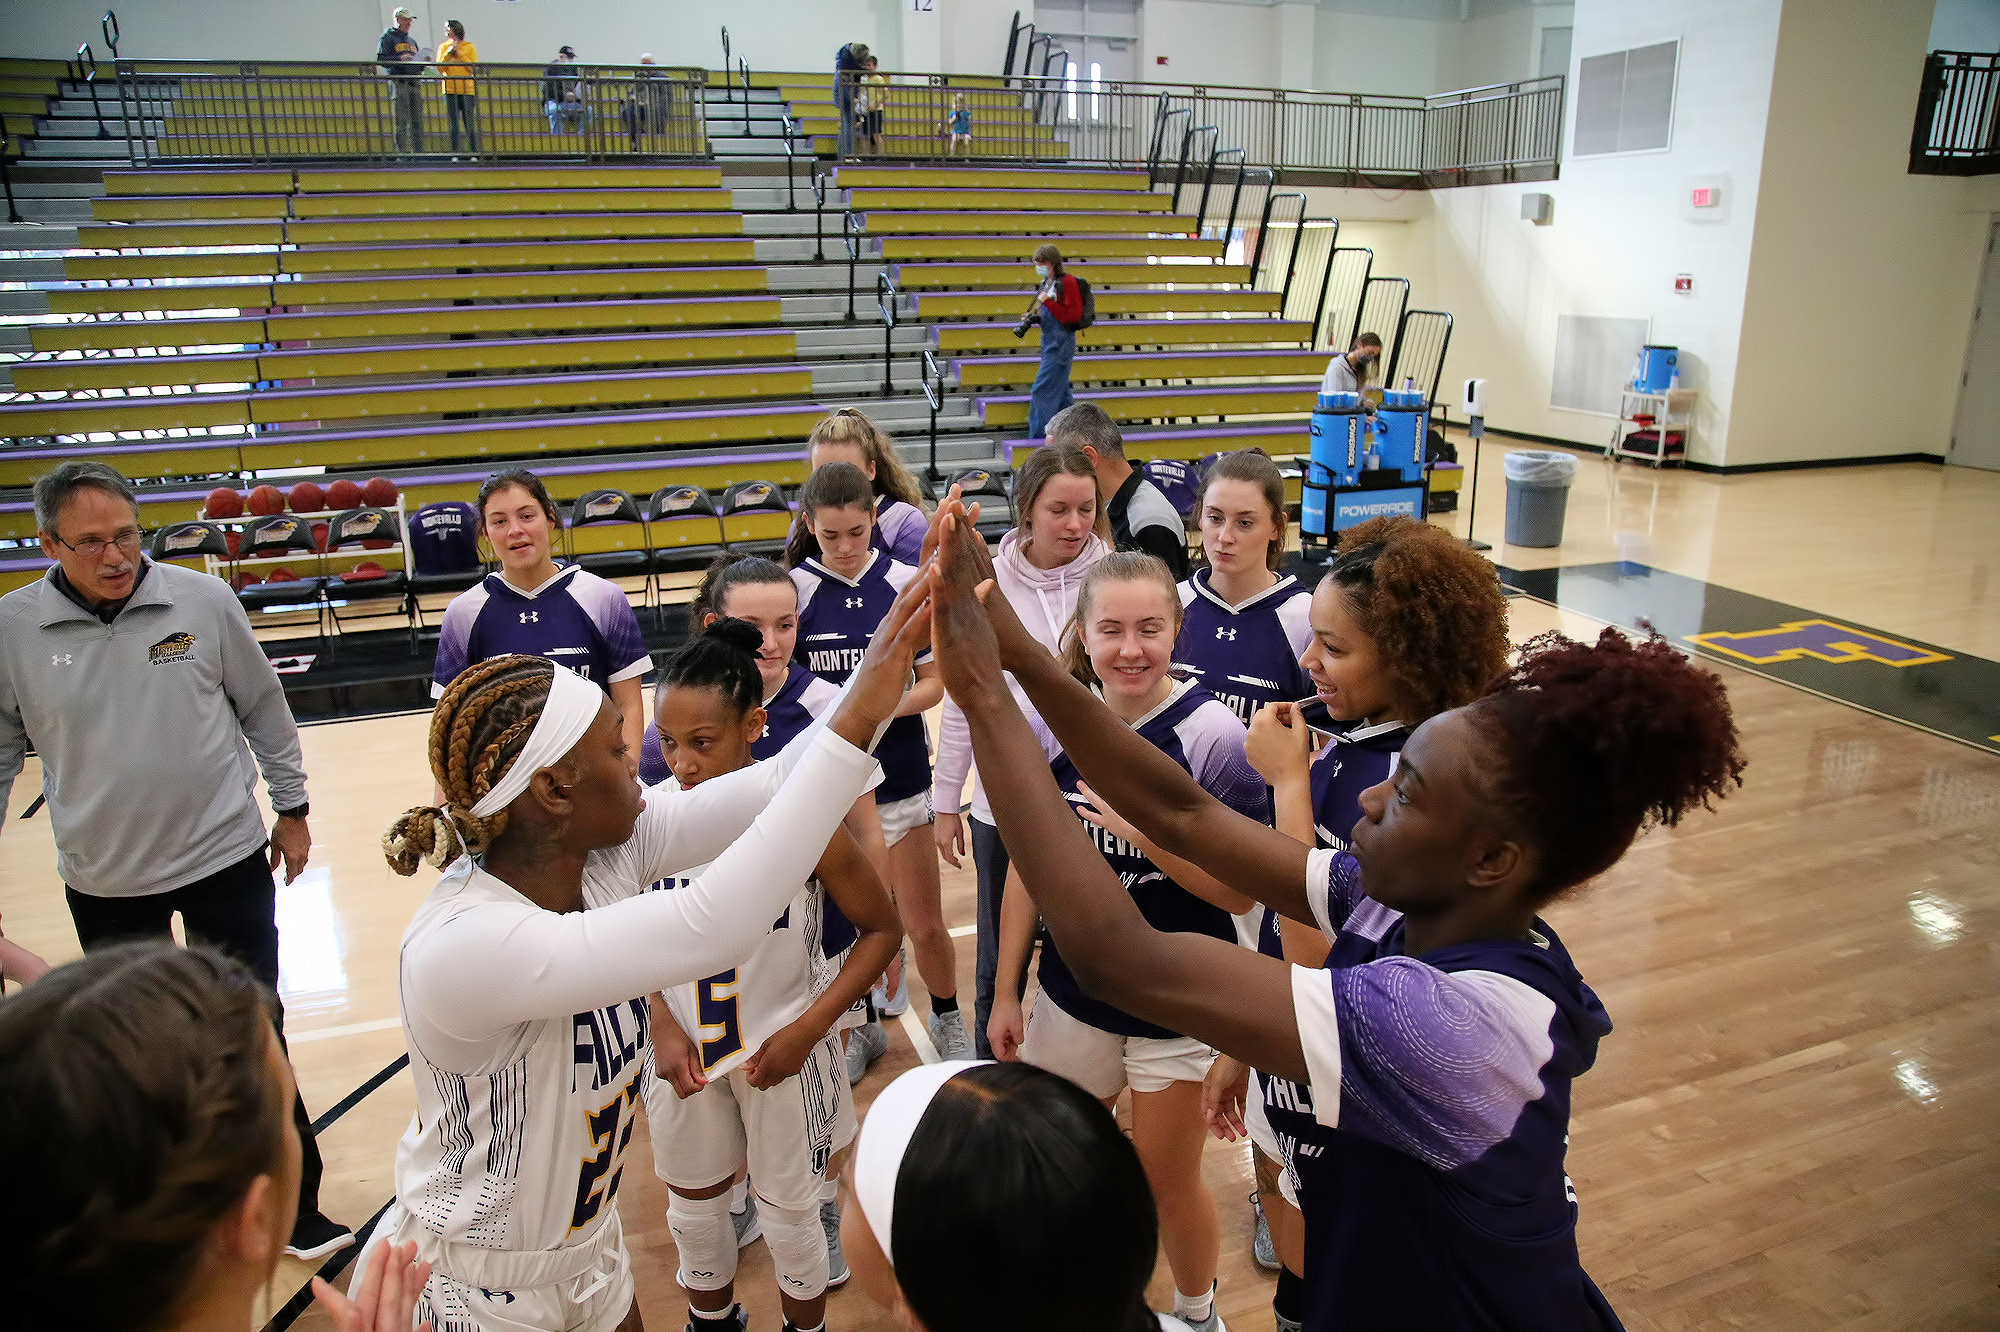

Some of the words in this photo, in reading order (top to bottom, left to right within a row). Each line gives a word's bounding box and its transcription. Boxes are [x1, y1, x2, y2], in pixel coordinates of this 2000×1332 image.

[1347, 417, 1357, 468] POWERADE
[1414, 415, 1423, 464] POWERADE
[1339, 501, 1415, 518] POWERADE
[153, 655, 195, 666] BASKETBALL
[694, 966, 746, 1073] 5
